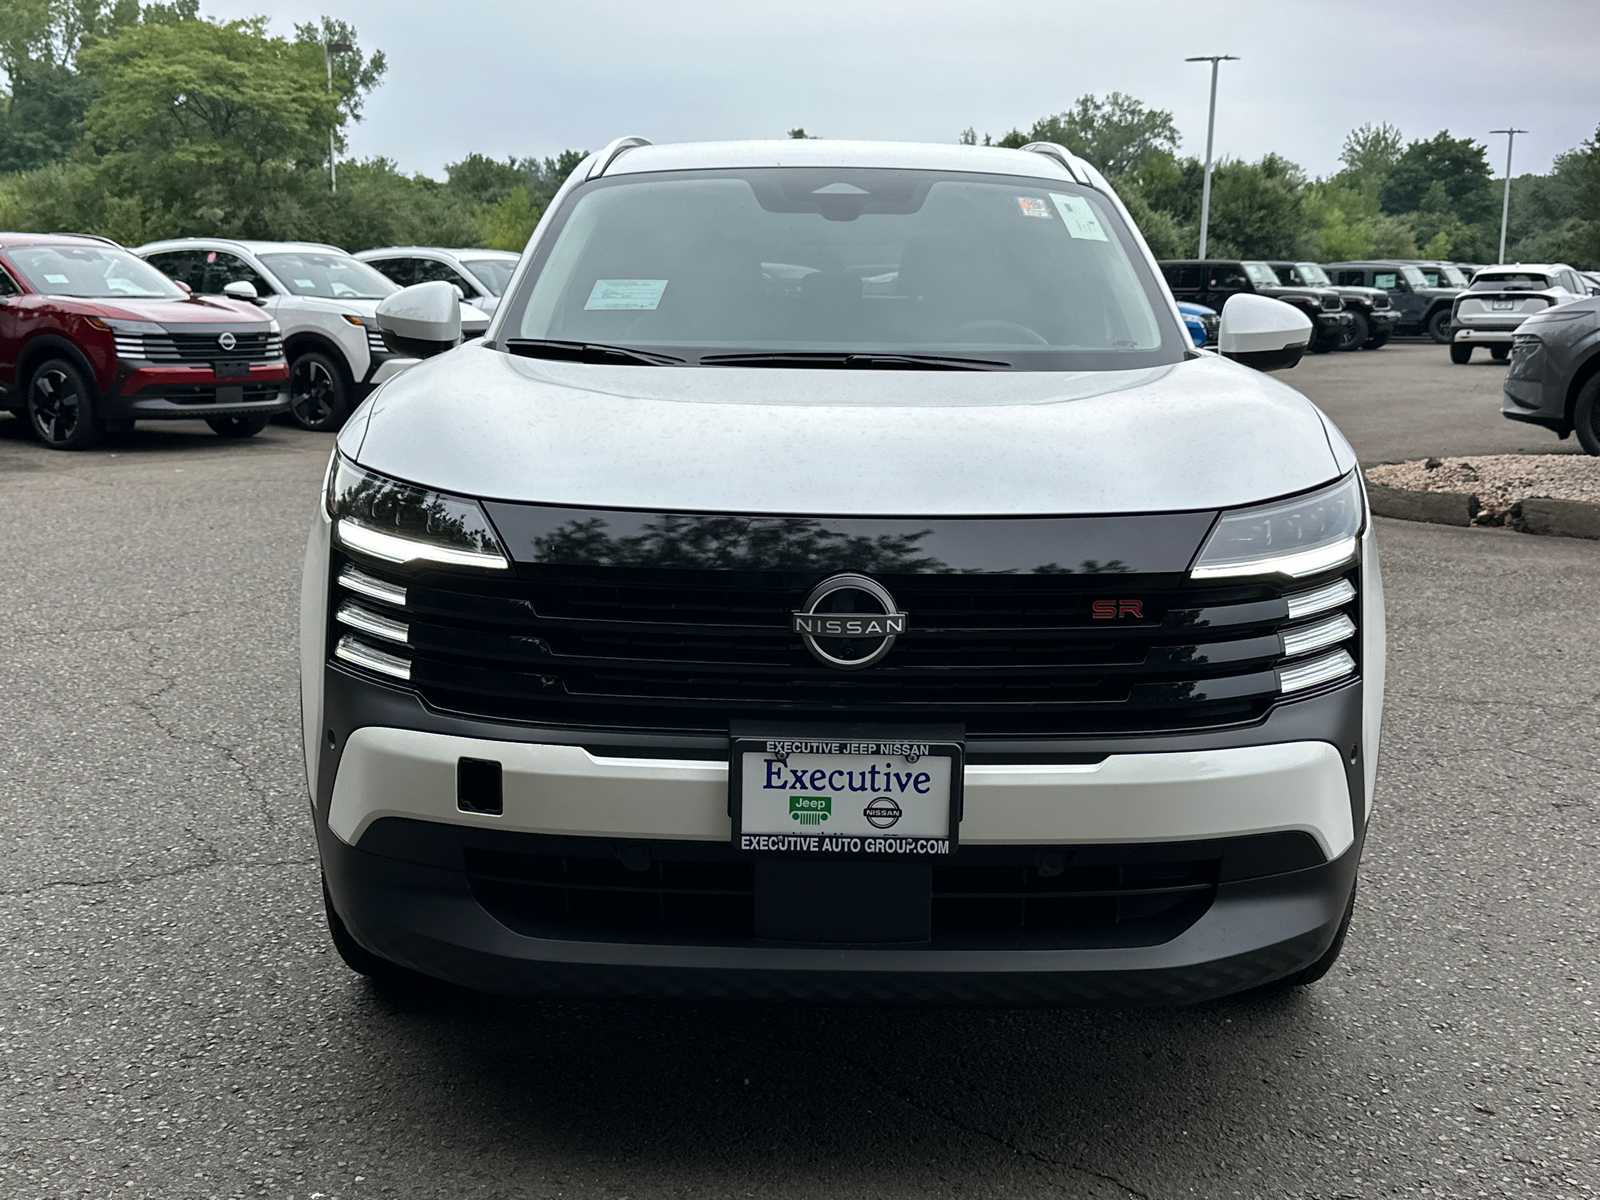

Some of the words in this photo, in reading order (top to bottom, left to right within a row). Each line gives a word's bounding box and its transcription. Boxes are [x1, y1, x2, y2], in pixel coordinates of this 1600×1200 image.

[1092, 599, 1143, 618] SR
[796, 618, 902, 634] NISSAN
[766, 741, 839, 754] EXECUTIVE
[843, 743, 877, 755] JEEP
[880, 744, 929, 756] NISSAN
[763, 758, 931, 794] Executive
[795, 798, 826, 810] Jeep
[866, 809, 900, 817] NISSAN
[741, 836, 819, 852] EXECUTIVE
[822, 838, 861, 853] AUTO
[864, 838, 949, 854] GROUP.COM
